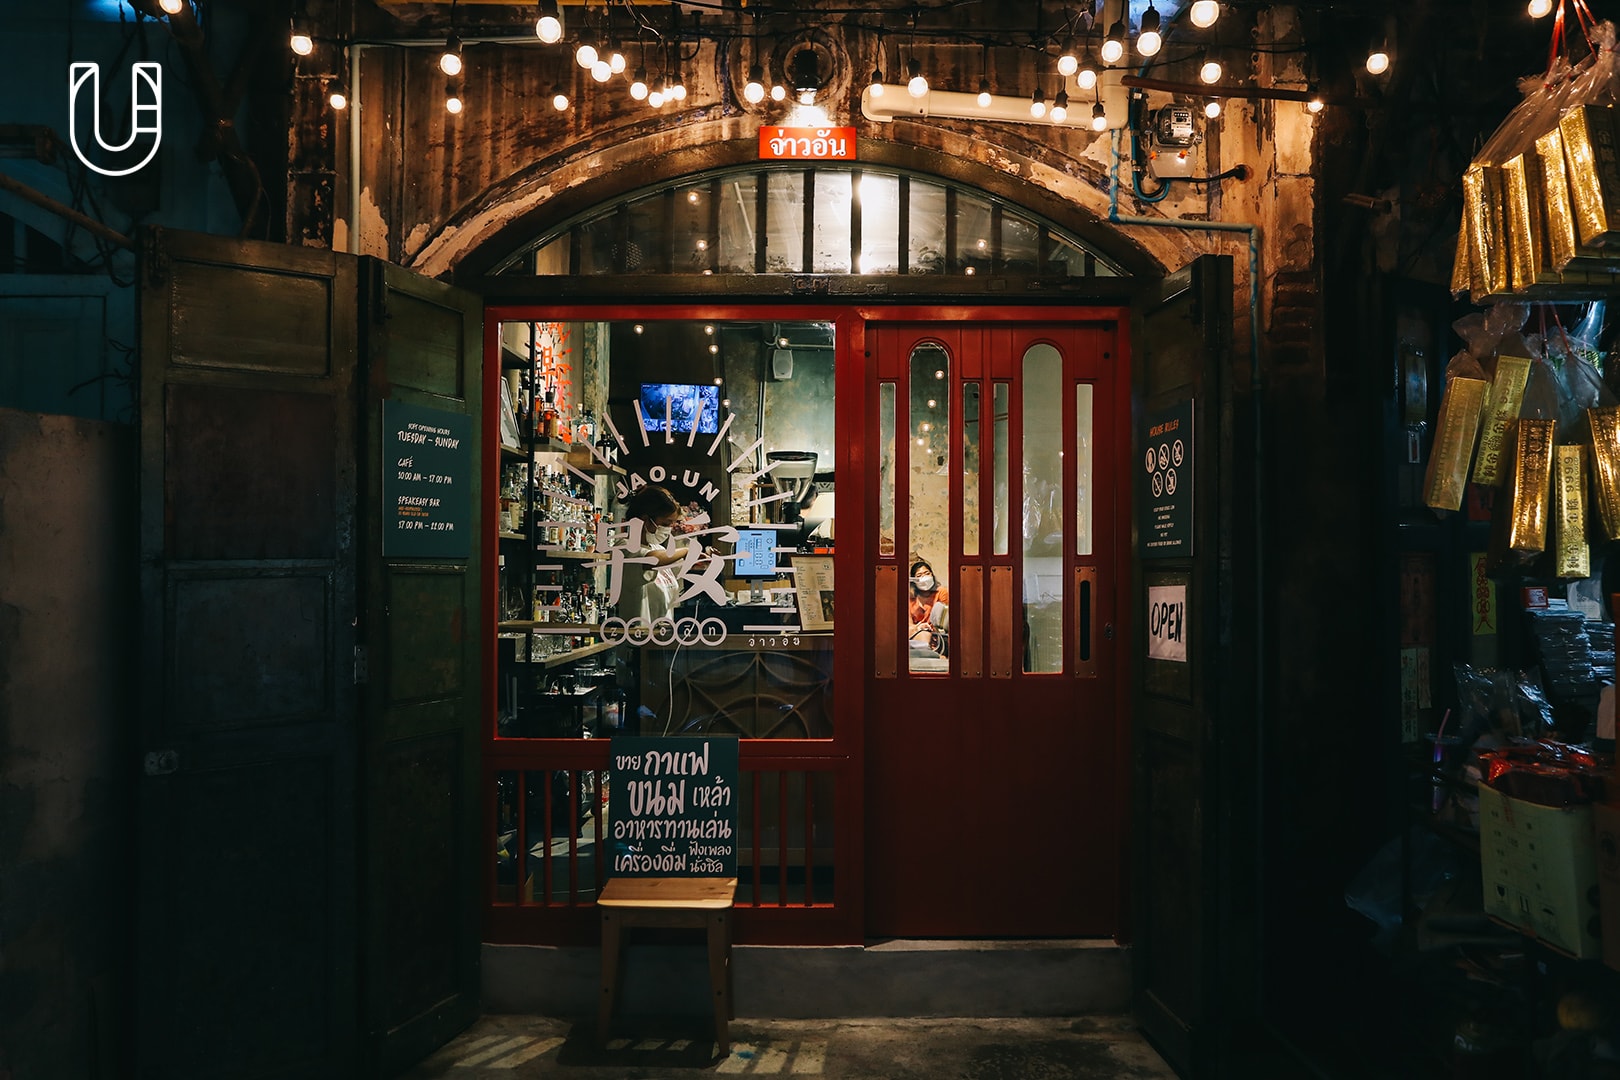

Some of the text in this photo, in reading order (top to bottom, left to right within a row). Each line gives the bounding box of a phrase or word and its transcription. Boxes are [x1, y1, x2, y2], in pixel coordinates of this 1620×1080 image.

[769, 129, 846, 157] จ่าวอัน
[397, 430, 427, 445] TUESDAY
[435, 437, 460, 449] SUNDAY
[1149, 418, 1180, 438] HOUSE RULES
[397, 456, 413, 468] CAFÉ
[412, 472, 422, 482] AM
[443, 475, 453, 485] PM
[398, 496, 441, 508] SPEAKEASY BAR
[414, 521, 423, 531] PM
[445, 522, 454, 532] PM
[581, 511, 750, 607] 早安
[1151, 602, 1183, 643] OPEN
[616, 742, 710, 776] ขาย กาแฟ
[627, 775, 731, 817] ขนม เหล้า
[614, 810, 732, 840] อาหารทานเล่น
[614, 842, 686, 873] เครื่องดื่ม
[688, 841, 732, 856] ฟังเพลง
